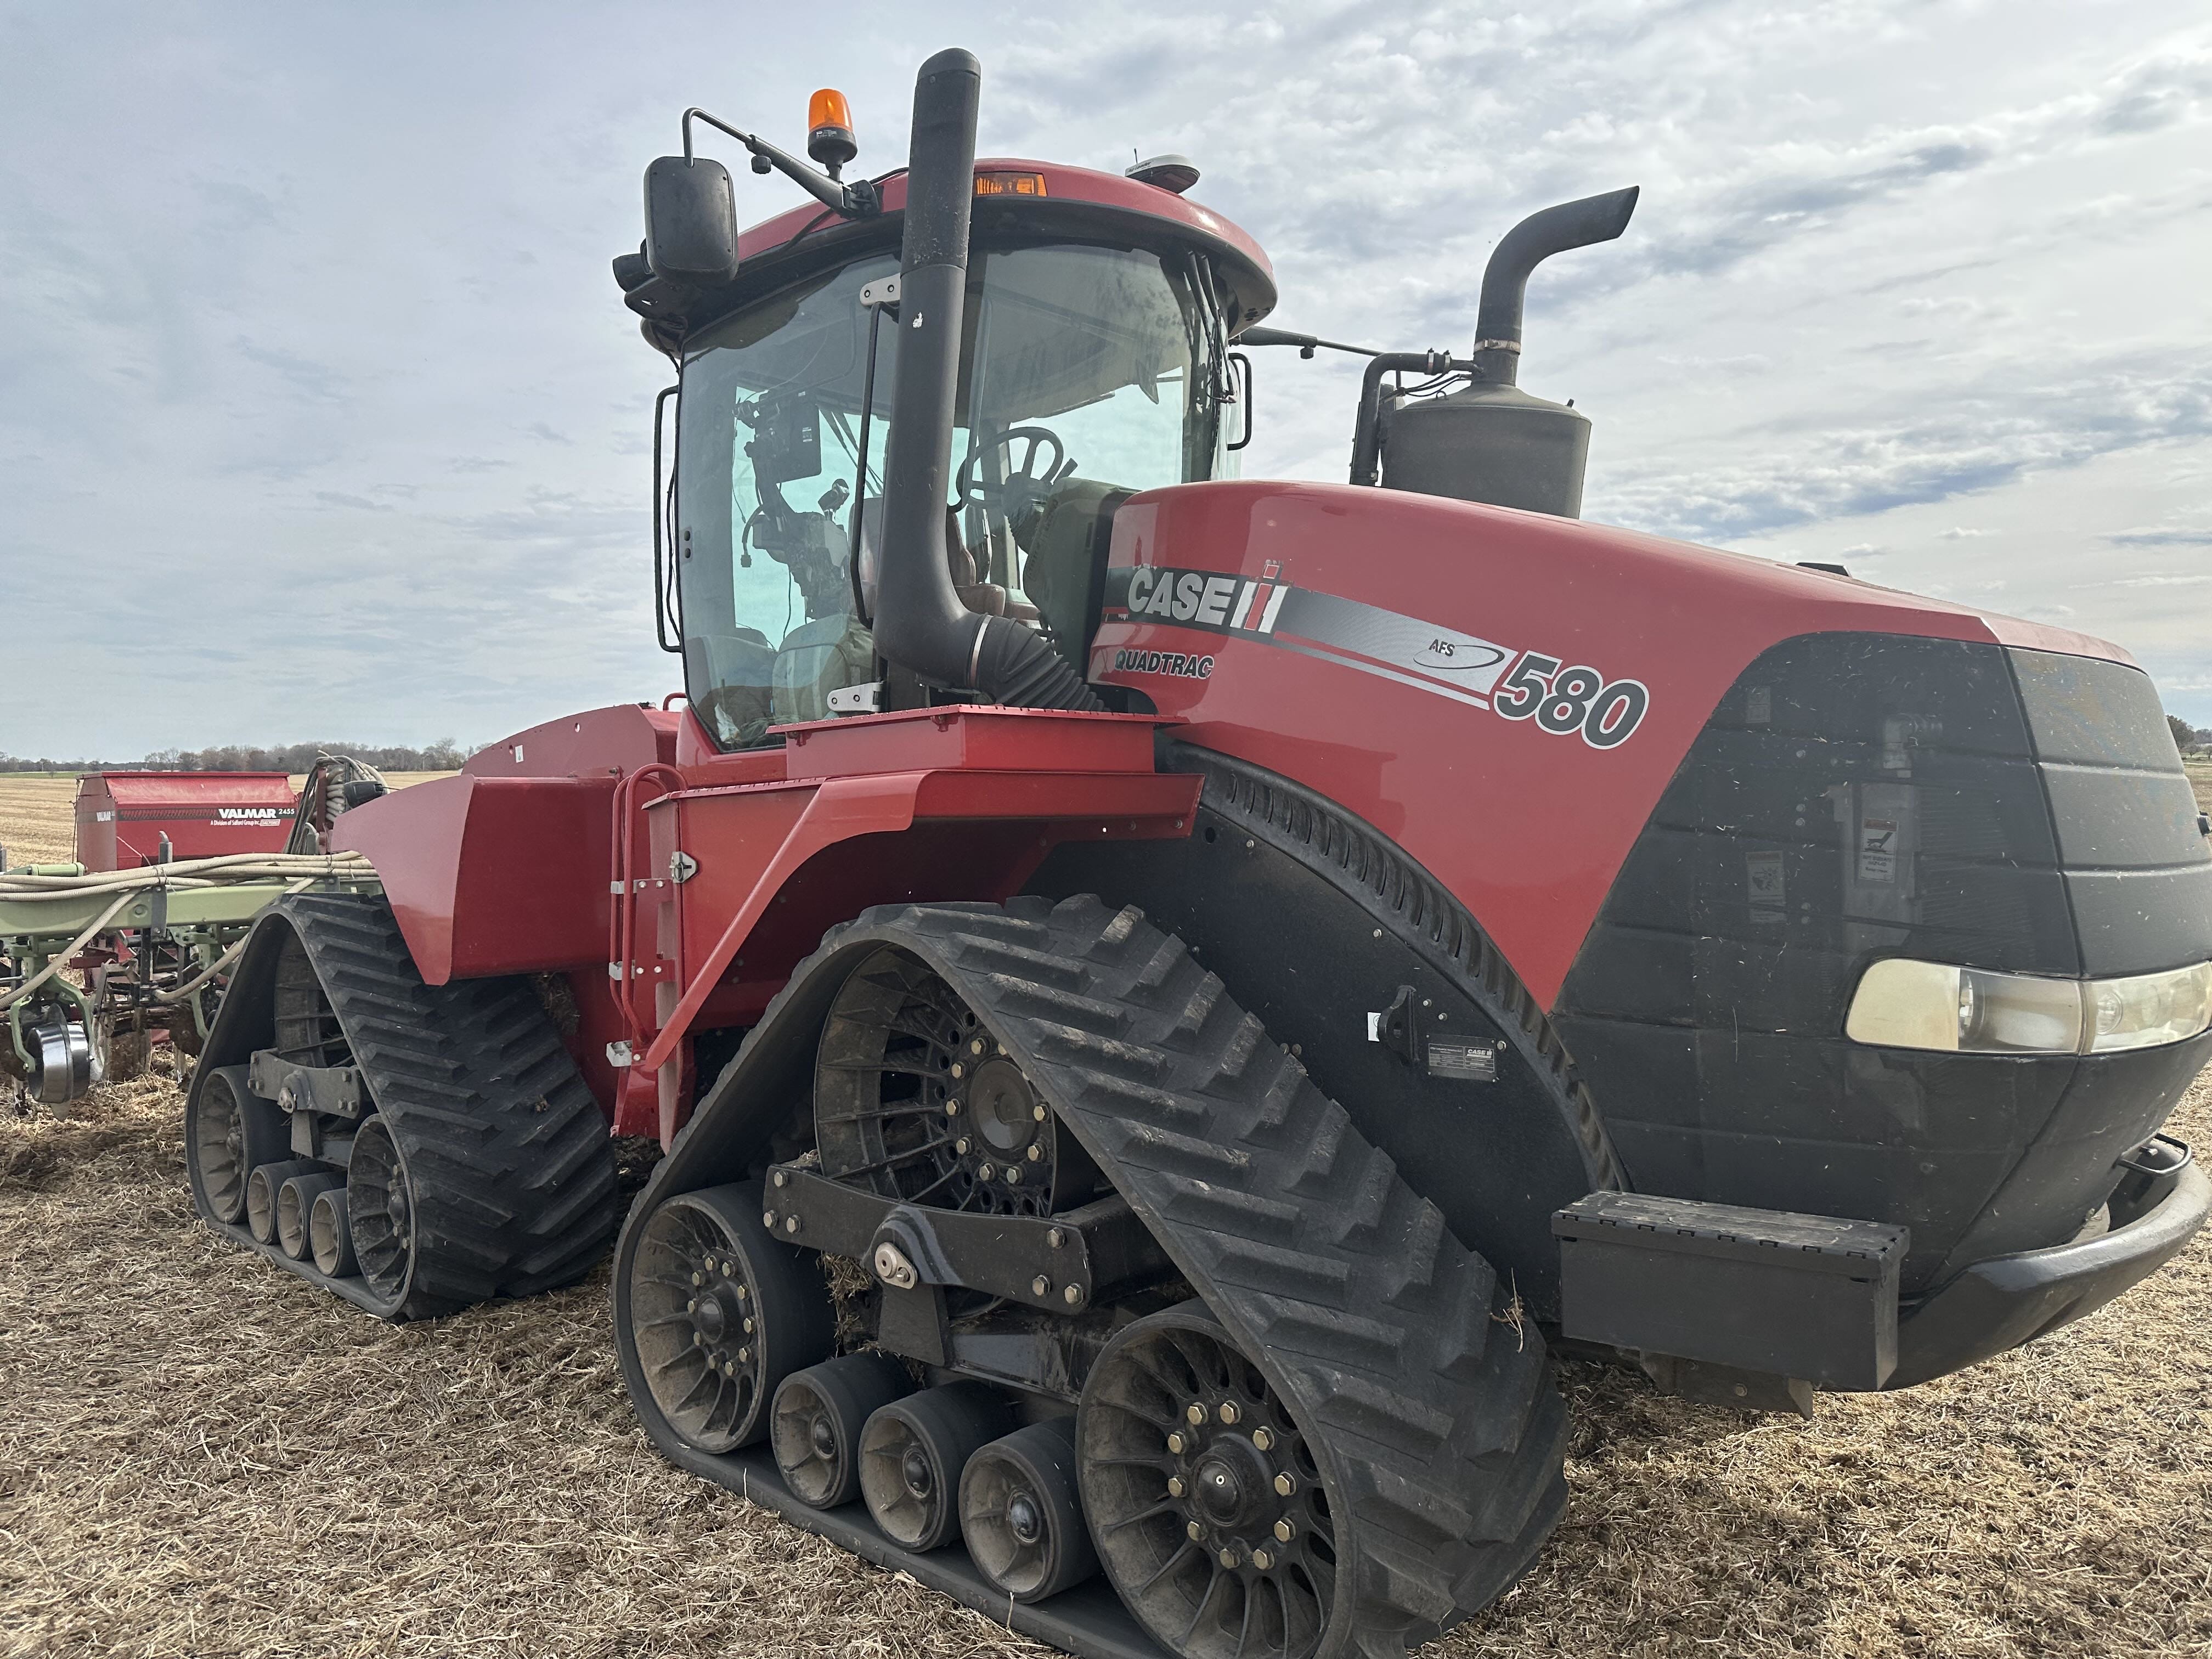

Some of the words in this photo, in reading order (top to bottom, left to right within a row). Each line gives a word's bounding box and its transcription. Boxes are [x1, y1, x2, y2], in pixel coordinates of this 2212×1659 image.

[1128, 568, 1237, 625] CASE
[1428, 639, 1455, 657] AFS
[1114, 649, 1215, 680] QUADTRAC
[1493, 650, 1650, 750] 580
[218, 808, 277, 819] VALMAR
